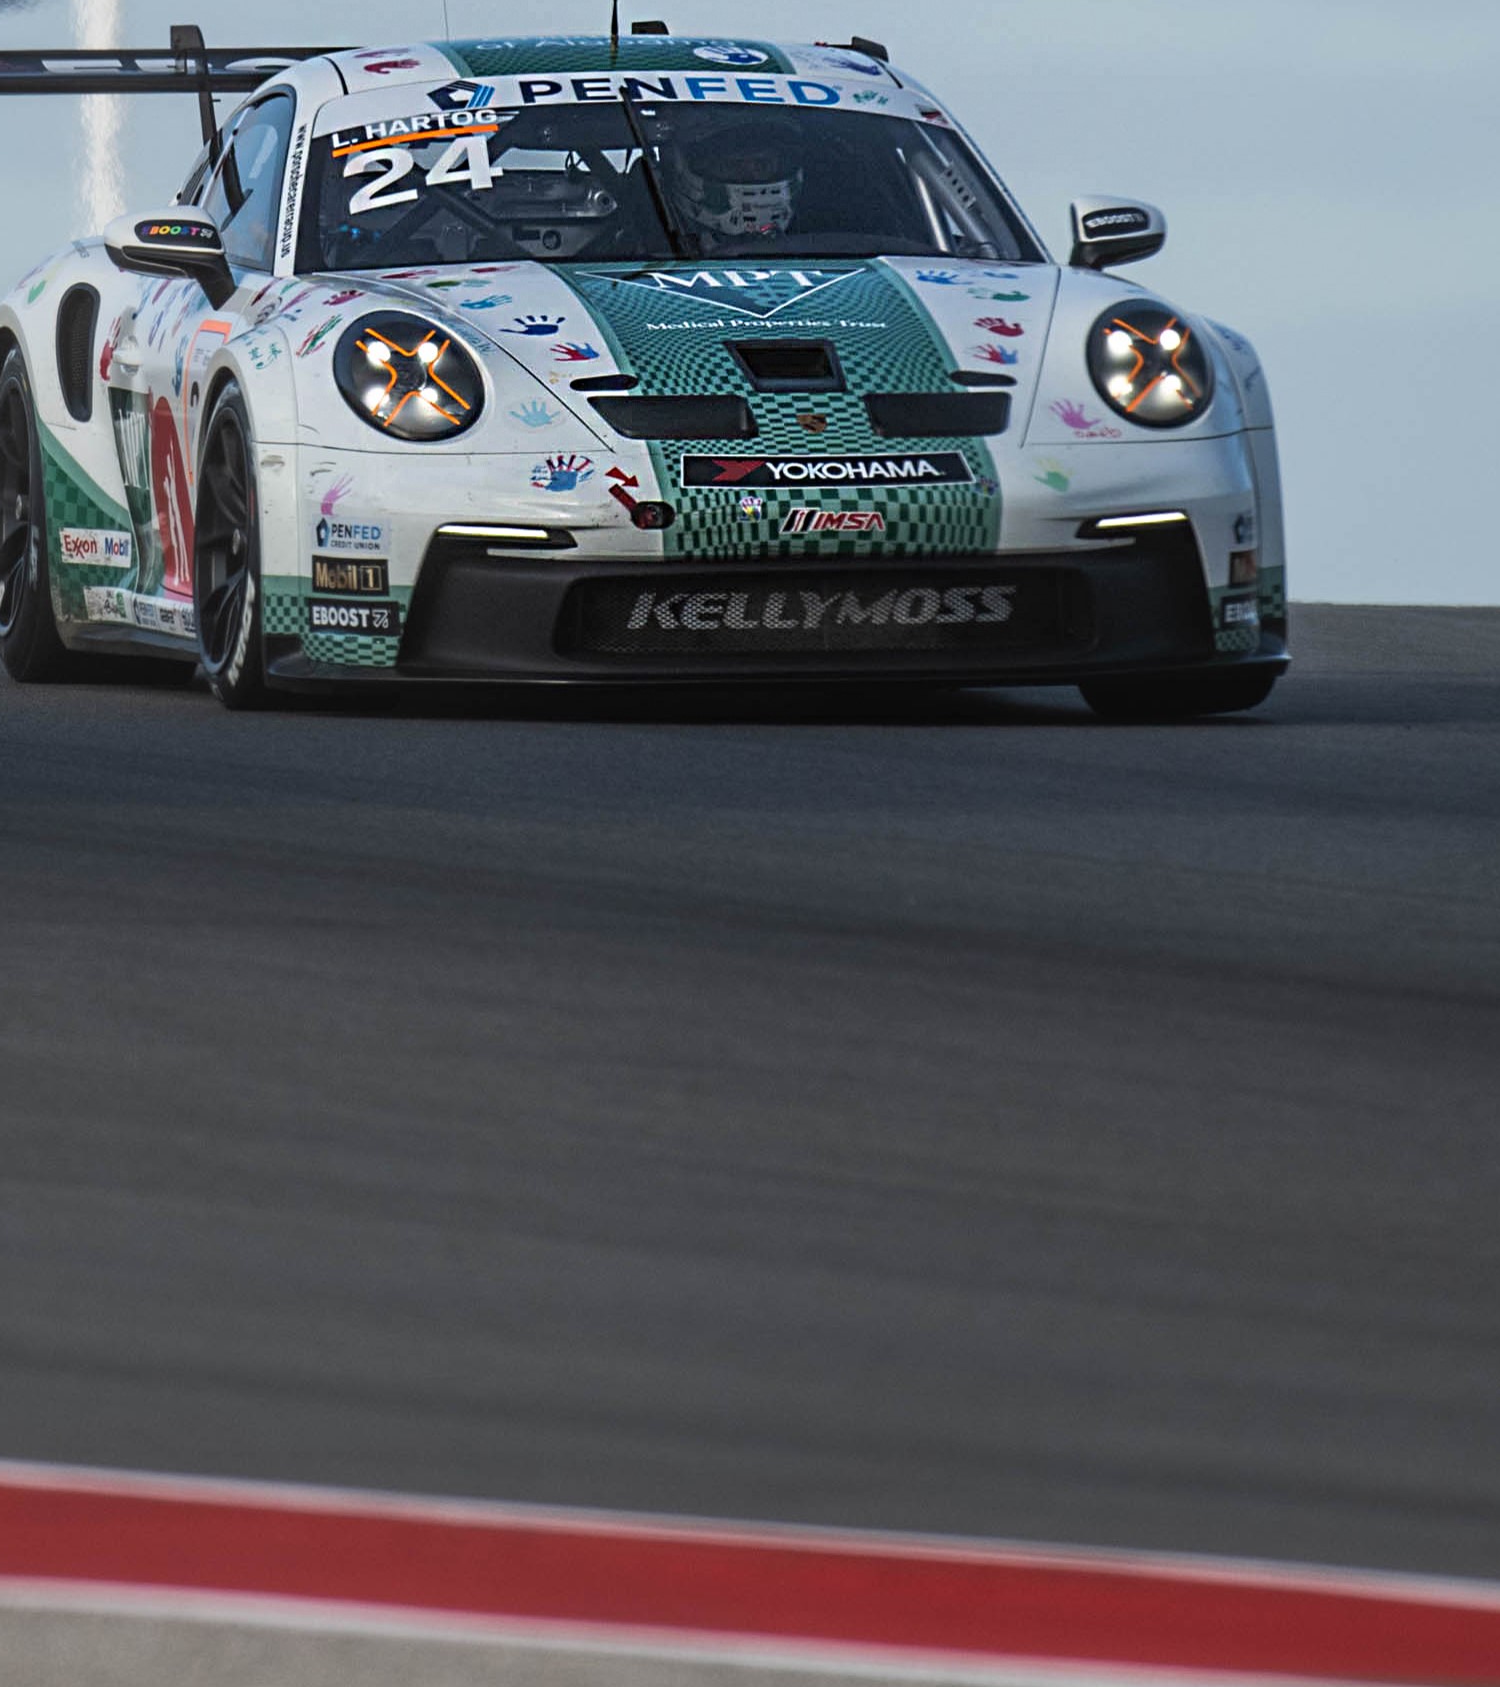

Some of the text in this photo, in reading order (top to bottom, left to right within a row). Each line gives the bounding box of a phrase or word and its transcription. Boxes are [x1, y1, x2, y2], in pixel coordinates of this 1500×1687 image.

[517, 76, 841, 106] PENFED
[331, 109, 498, 148] L. HARTOG
[343, 136, 504, 214] 24
[141, 225, 201, 236] EBOOST
[645, 269, 823, 289] MPT
[646, 318, 887, 330] Medical Properties Trust
[766, 460, 941, 482] YOKOHAMA
[331, 523, 382, 540] PENFED
[811, 512, 885, 531] IMSA
[63, 534, 129, 559] Exxon Mobil
[354, 541, 381, 551] UNION
[315, 561, 358, 590] Mobil
[312, 605, 370, 628] EBOOST
[627, 585, 1017, 630] KELLYMOSS
